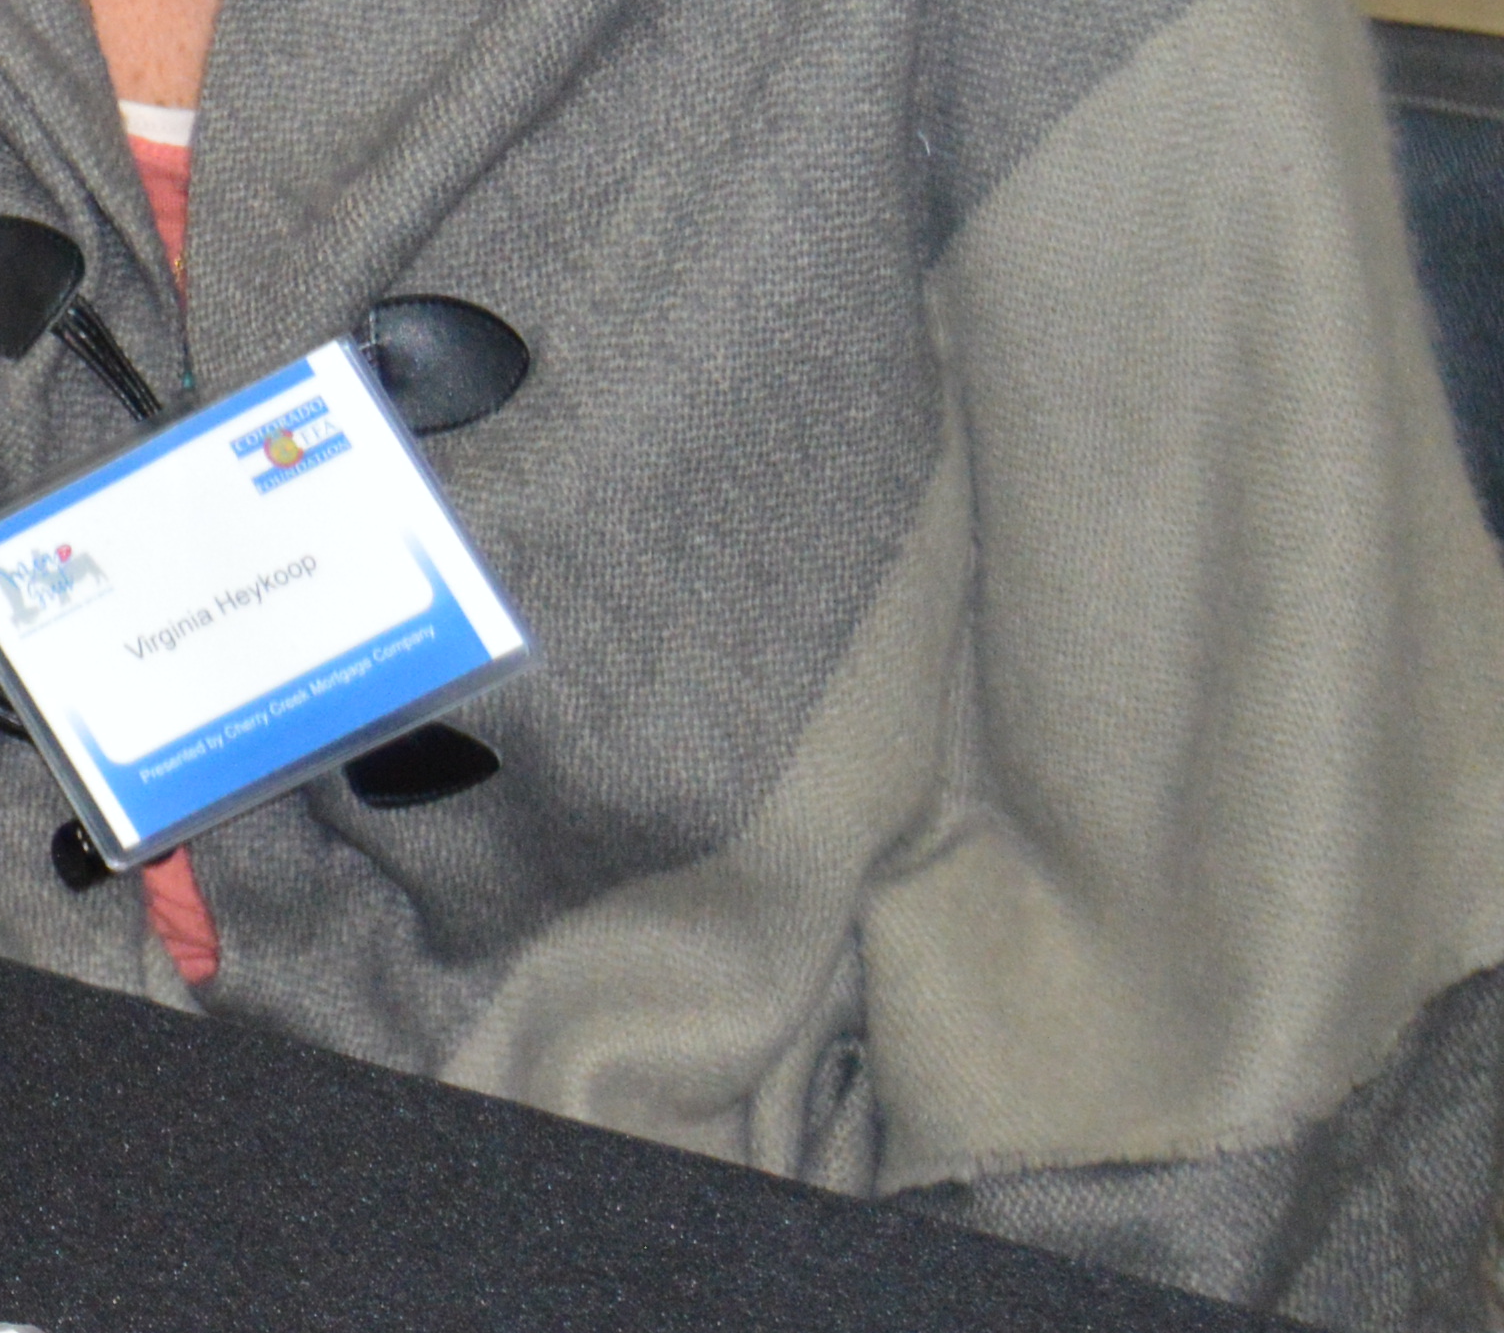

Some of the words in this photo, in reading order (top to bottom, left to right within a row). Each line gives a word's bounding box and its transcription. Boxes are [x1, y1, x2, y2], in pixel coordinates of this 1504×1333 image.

[123, 602, 214, 662] Virginia
[218, 550, 318, 617] Heykoop
[139, 742, 204, 784] Presented
[206, 730, 226, 753] by
[224, 707, 271, 741] Cherry
[270, 688, 309, 715] Creek
[373, 622, 437, 667] Company
